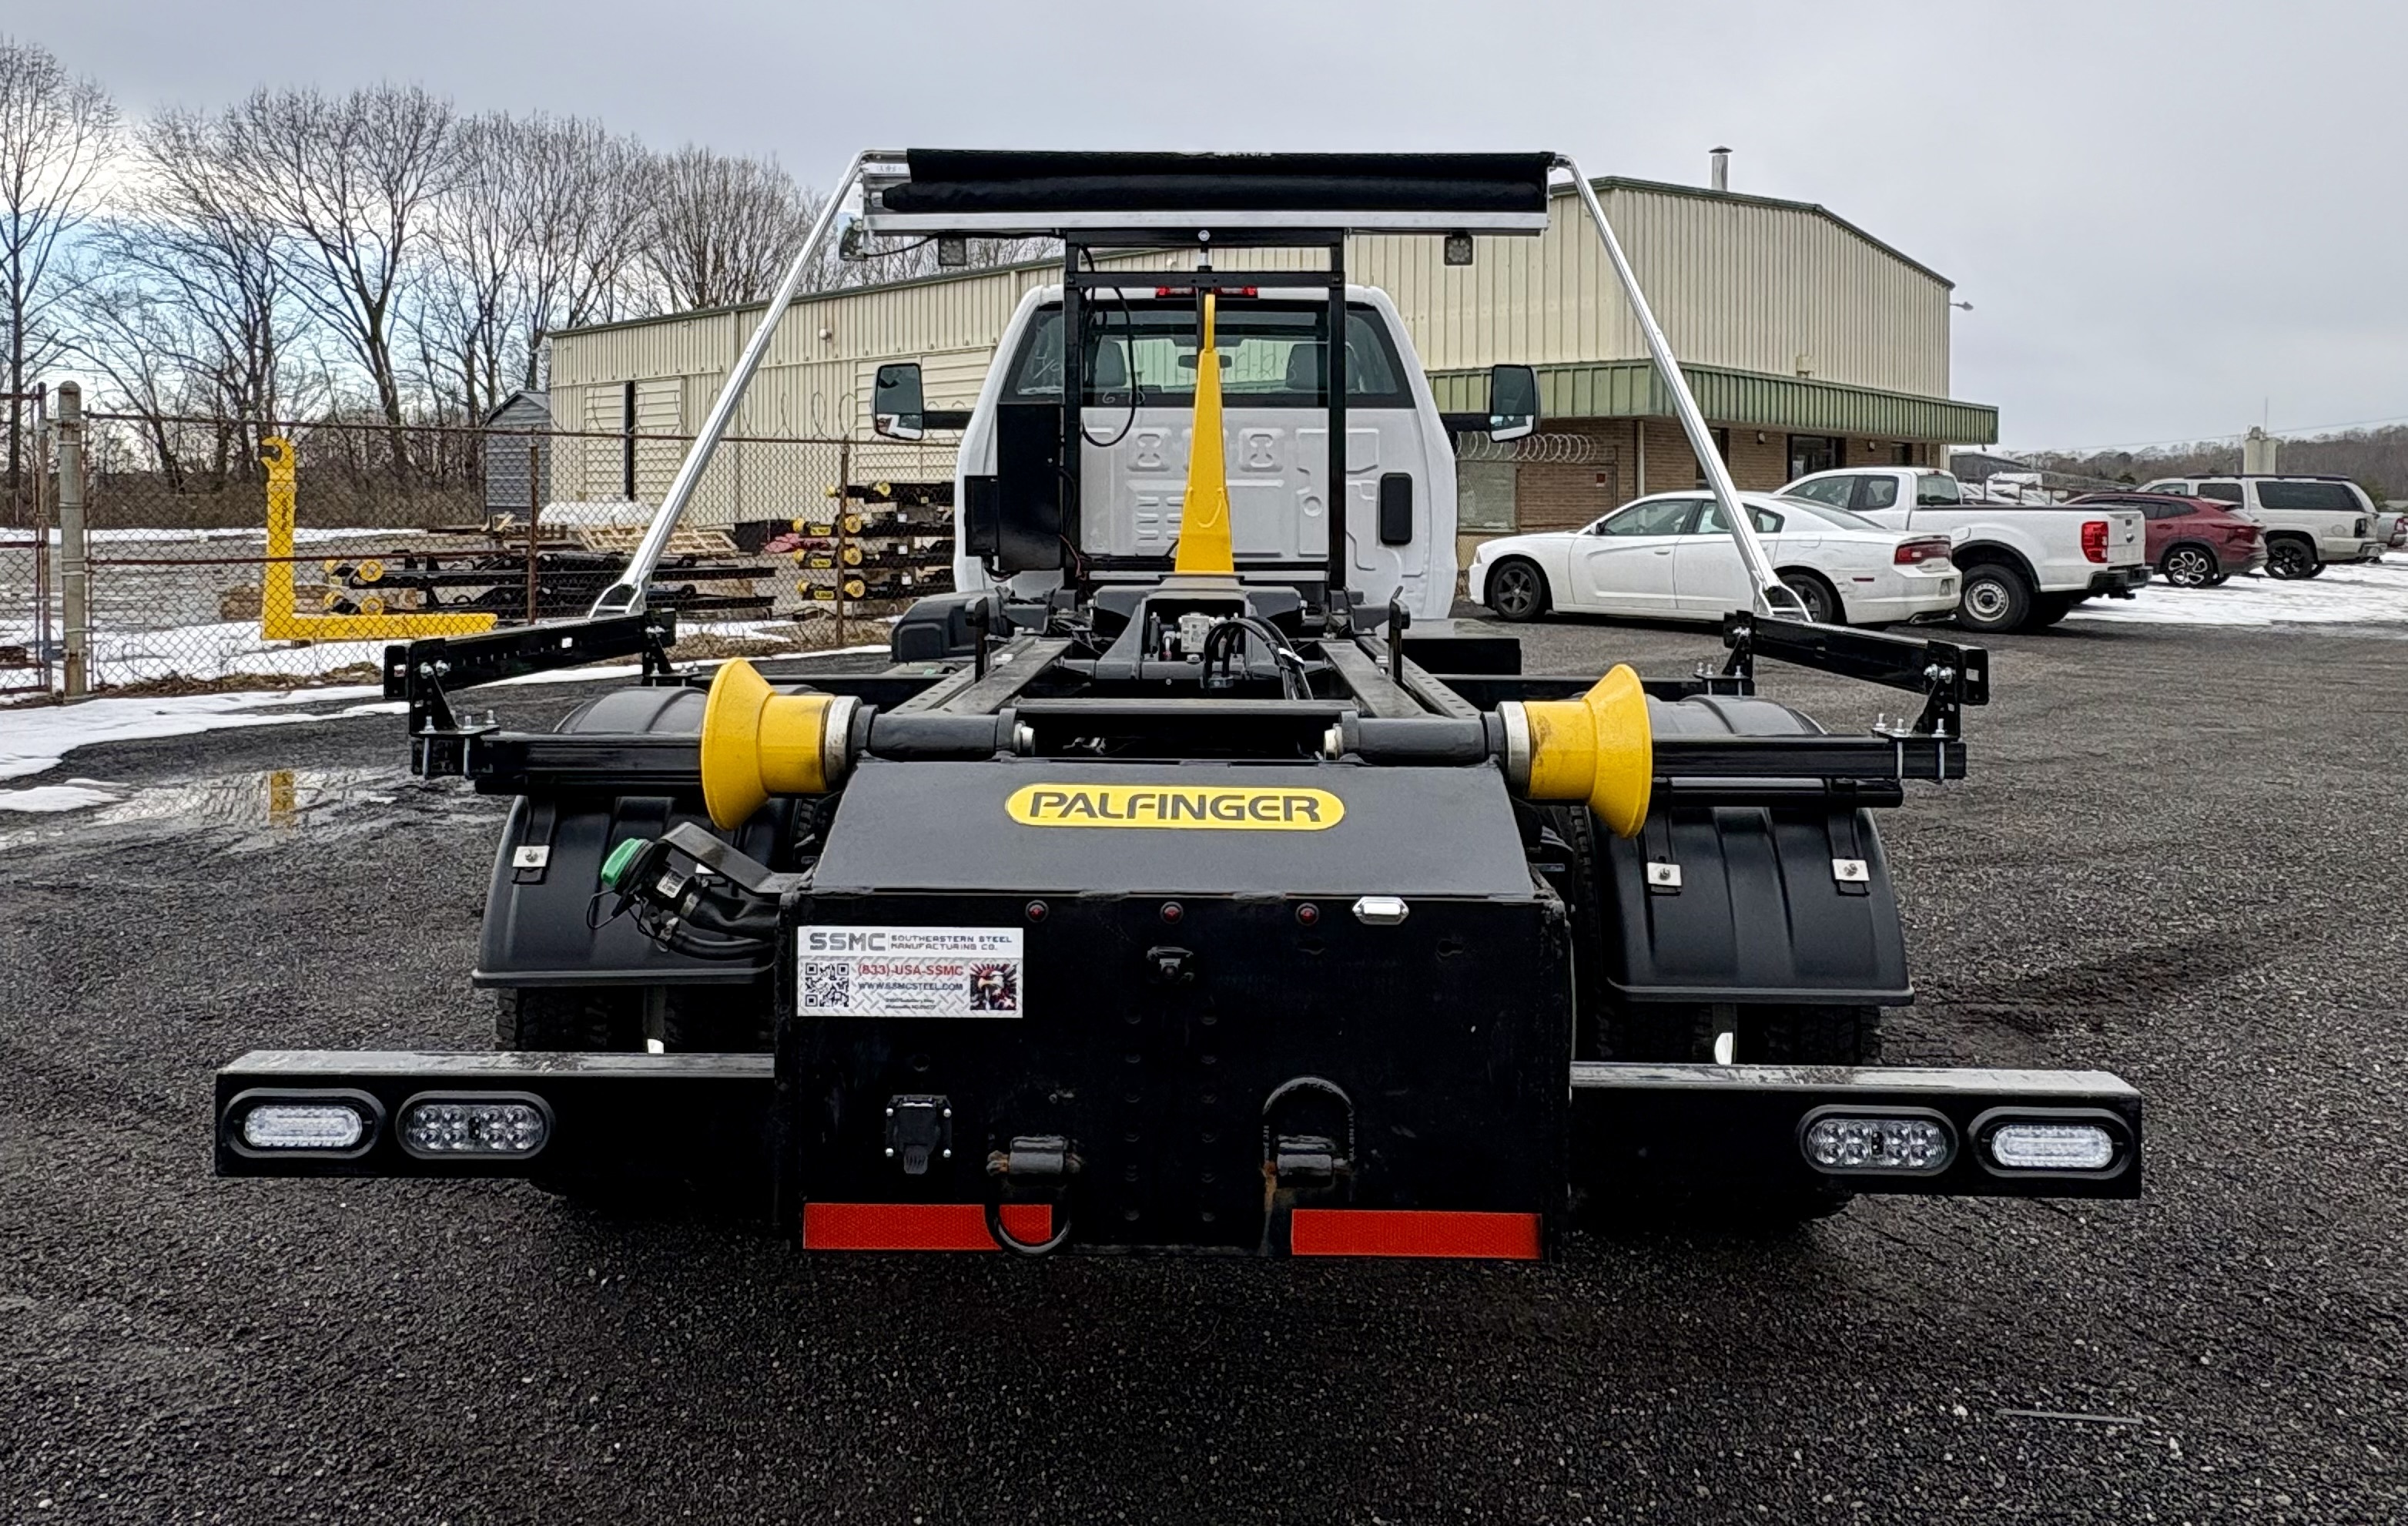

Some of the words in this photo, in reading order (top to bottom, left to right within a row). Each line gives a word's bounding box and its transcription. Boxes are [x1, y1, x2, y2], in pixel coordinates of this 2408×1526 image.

[1030, 792, 1321, 822] PALFINGER
[809, 932, 886, 951] SSMC
[858, 964, 964, 976] (833)-USA-SSMC
